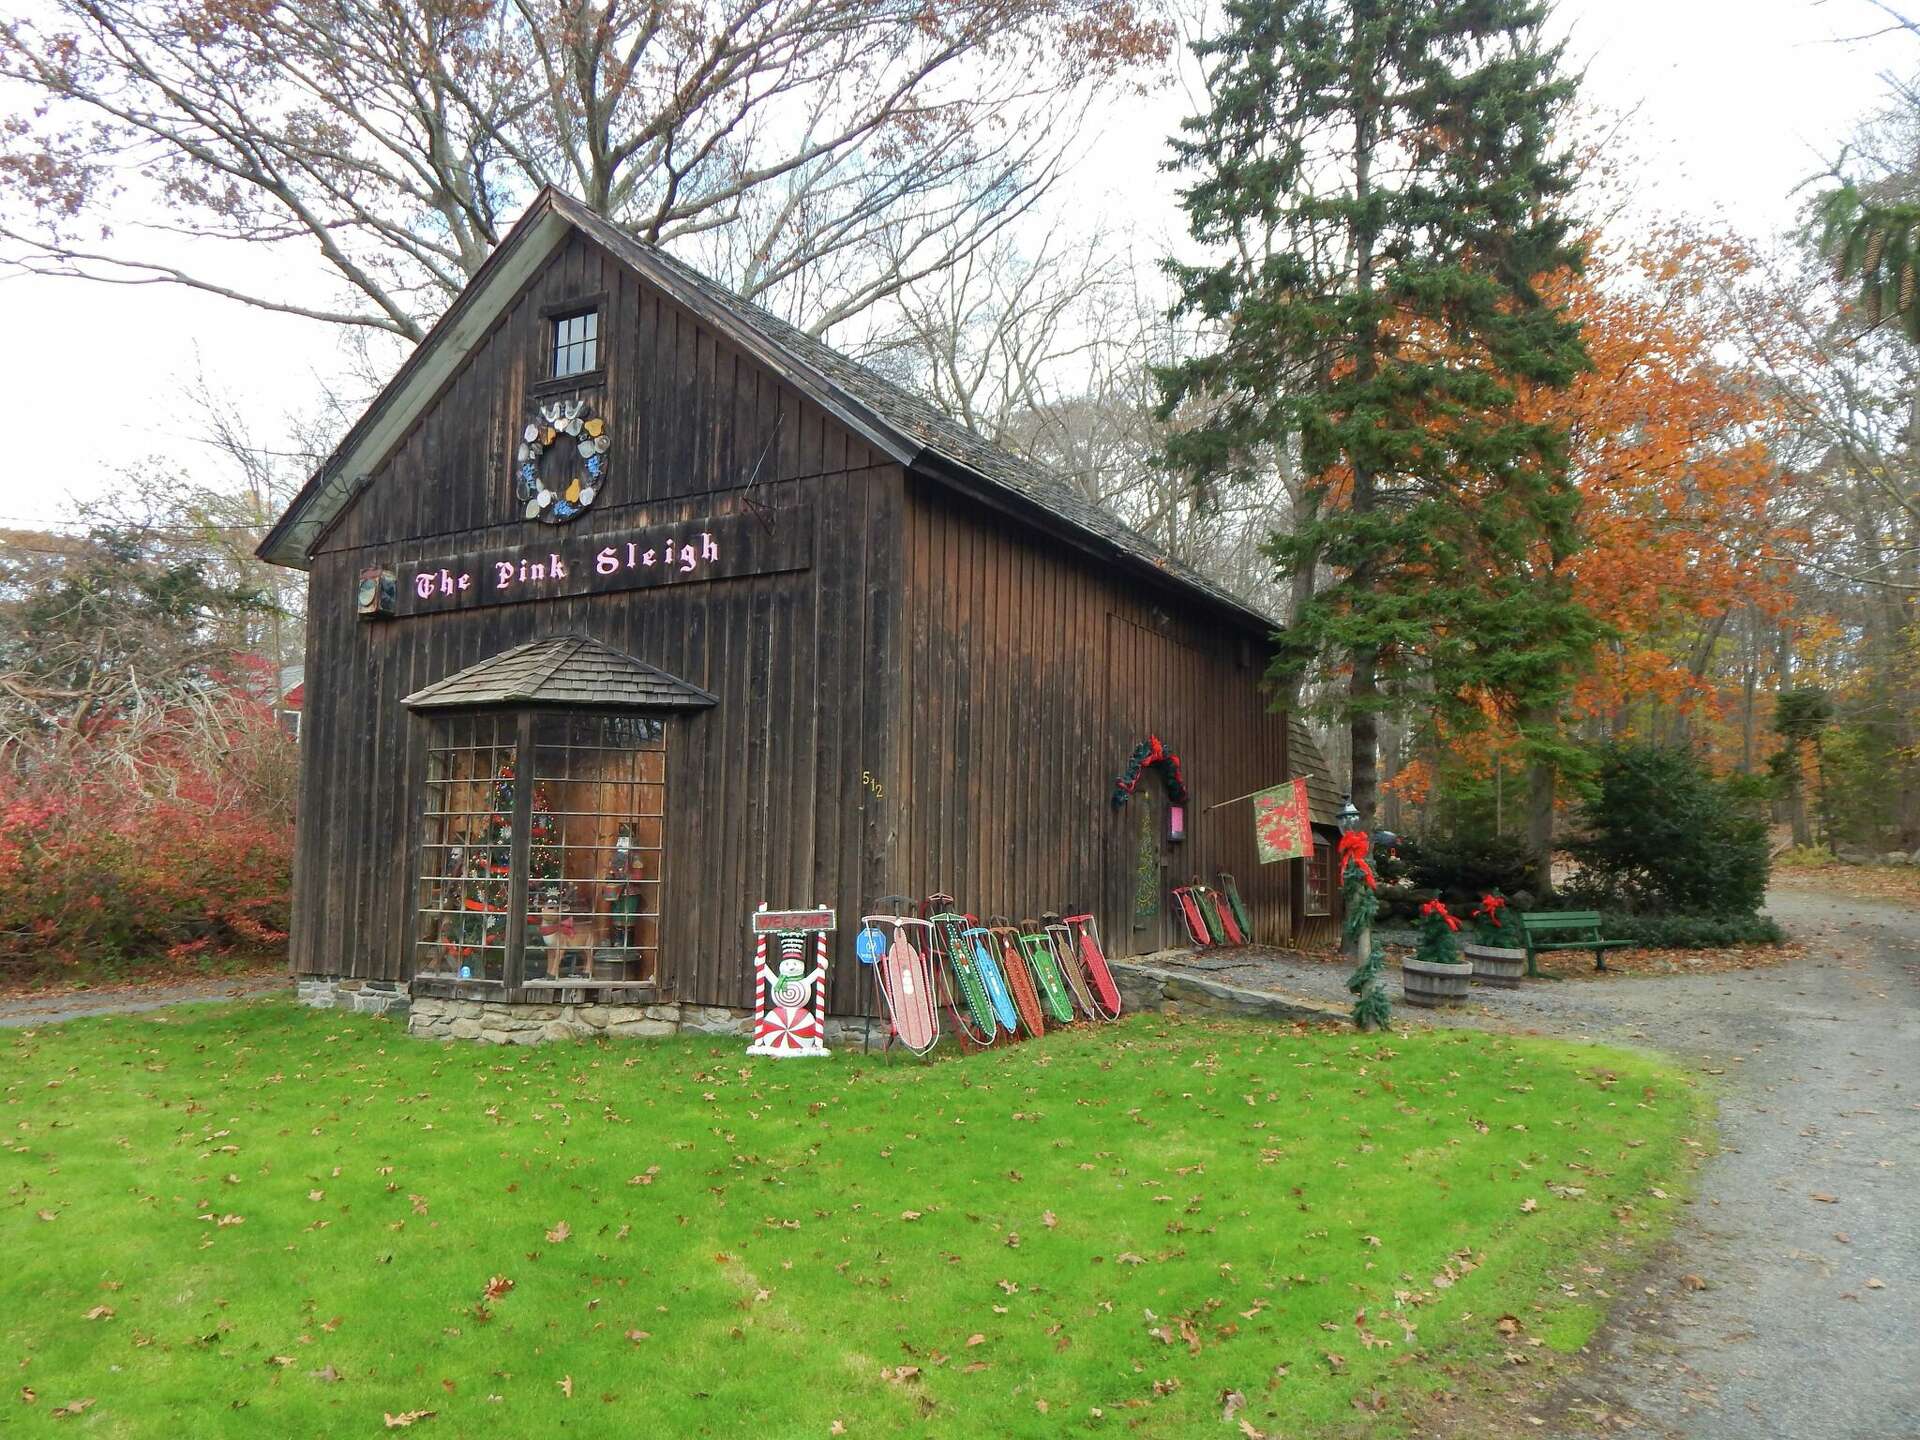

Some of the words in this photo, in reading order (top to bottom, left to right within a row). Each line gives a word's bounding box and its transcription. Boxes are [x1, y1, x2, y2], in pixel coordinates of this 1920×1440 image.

[415, 568, 471, 599] The
[495, 553, 568, 589] Pink
[596, 532, 718, 575] Sleigh
[863, 771, 883, 798] 512
[757, 912, 831, 929] WELCOME
